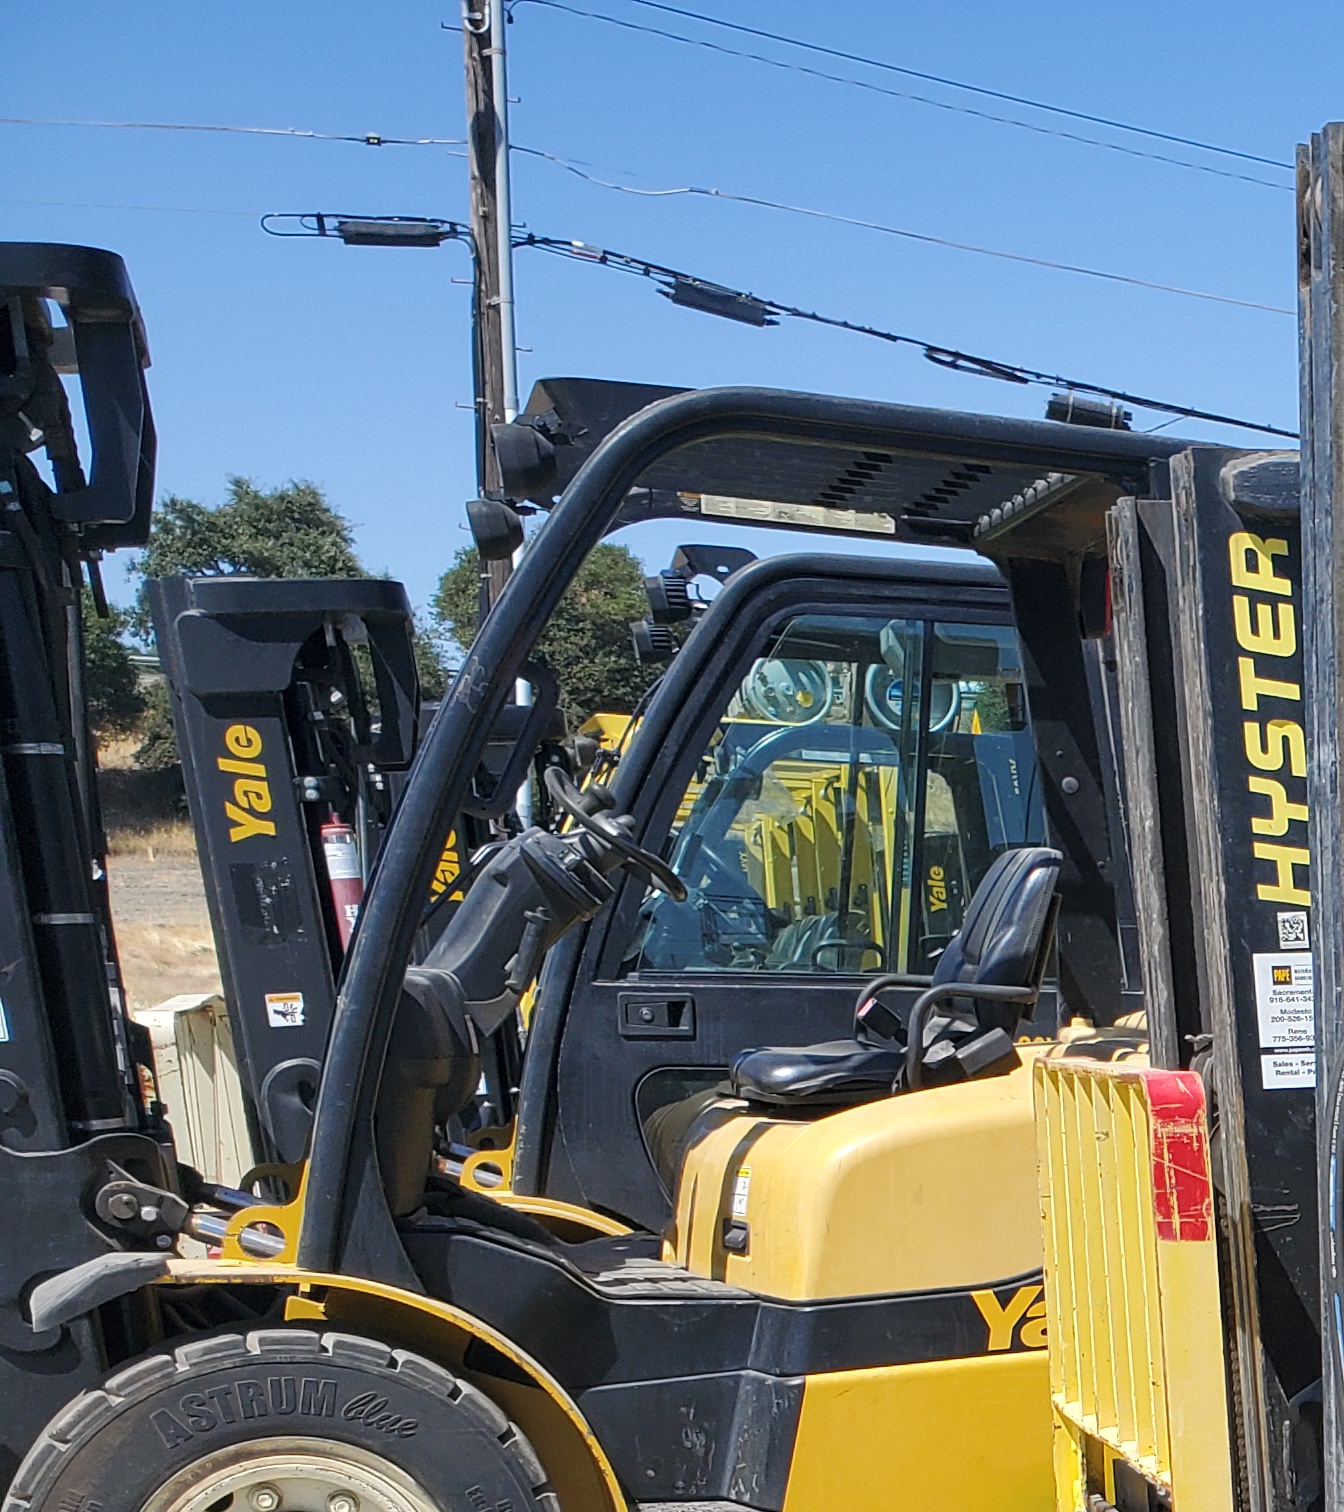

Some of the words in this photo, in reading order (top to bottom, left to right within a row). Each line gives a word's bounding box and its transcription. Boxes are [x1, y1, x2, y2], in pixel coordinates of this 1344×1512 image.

[1229, 530, 1311, 907] HYSTER
[217, 724, 276, 842] Yale
[928, 865, 947, 912] Yale
[150, 1376, 338, 1450] ASTRUM
[341, 1391, 419, 1438] blue
